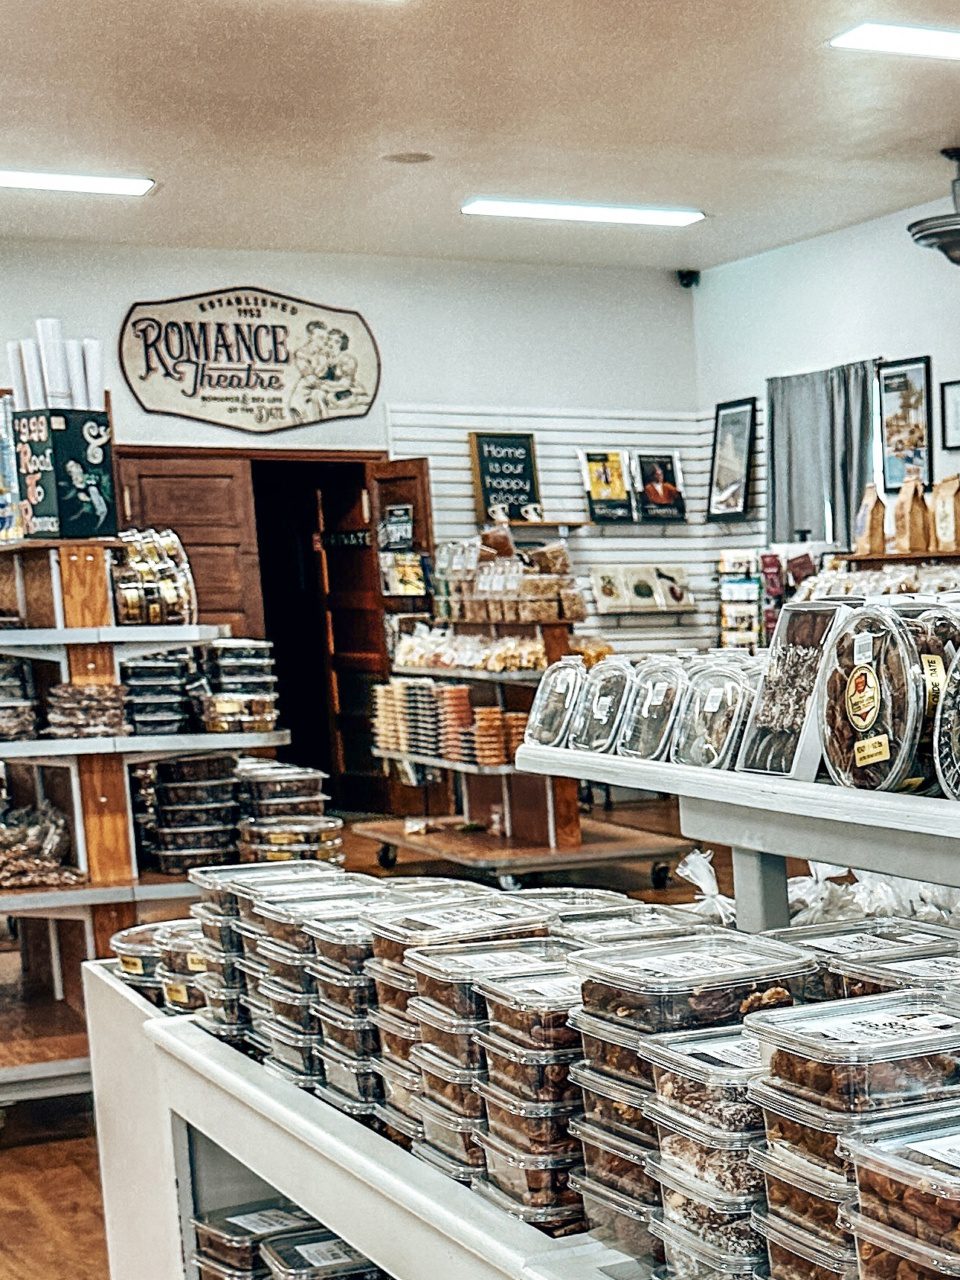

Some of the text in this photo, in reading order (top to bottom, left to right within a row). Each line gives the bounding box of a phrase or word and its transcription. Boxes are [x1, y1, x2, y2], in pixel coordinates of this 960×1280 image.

[198, 296, 298, 315] ESTABLISHED
[132, 317, 290, 381] ROMANCE
[173, 359, 283, 397] Theatre
[483, 444, 527, 459] Home
[489, 462, 524, 474] is our
[485, 475, 531, 492] happy
[490, 491, 528, 505] place
